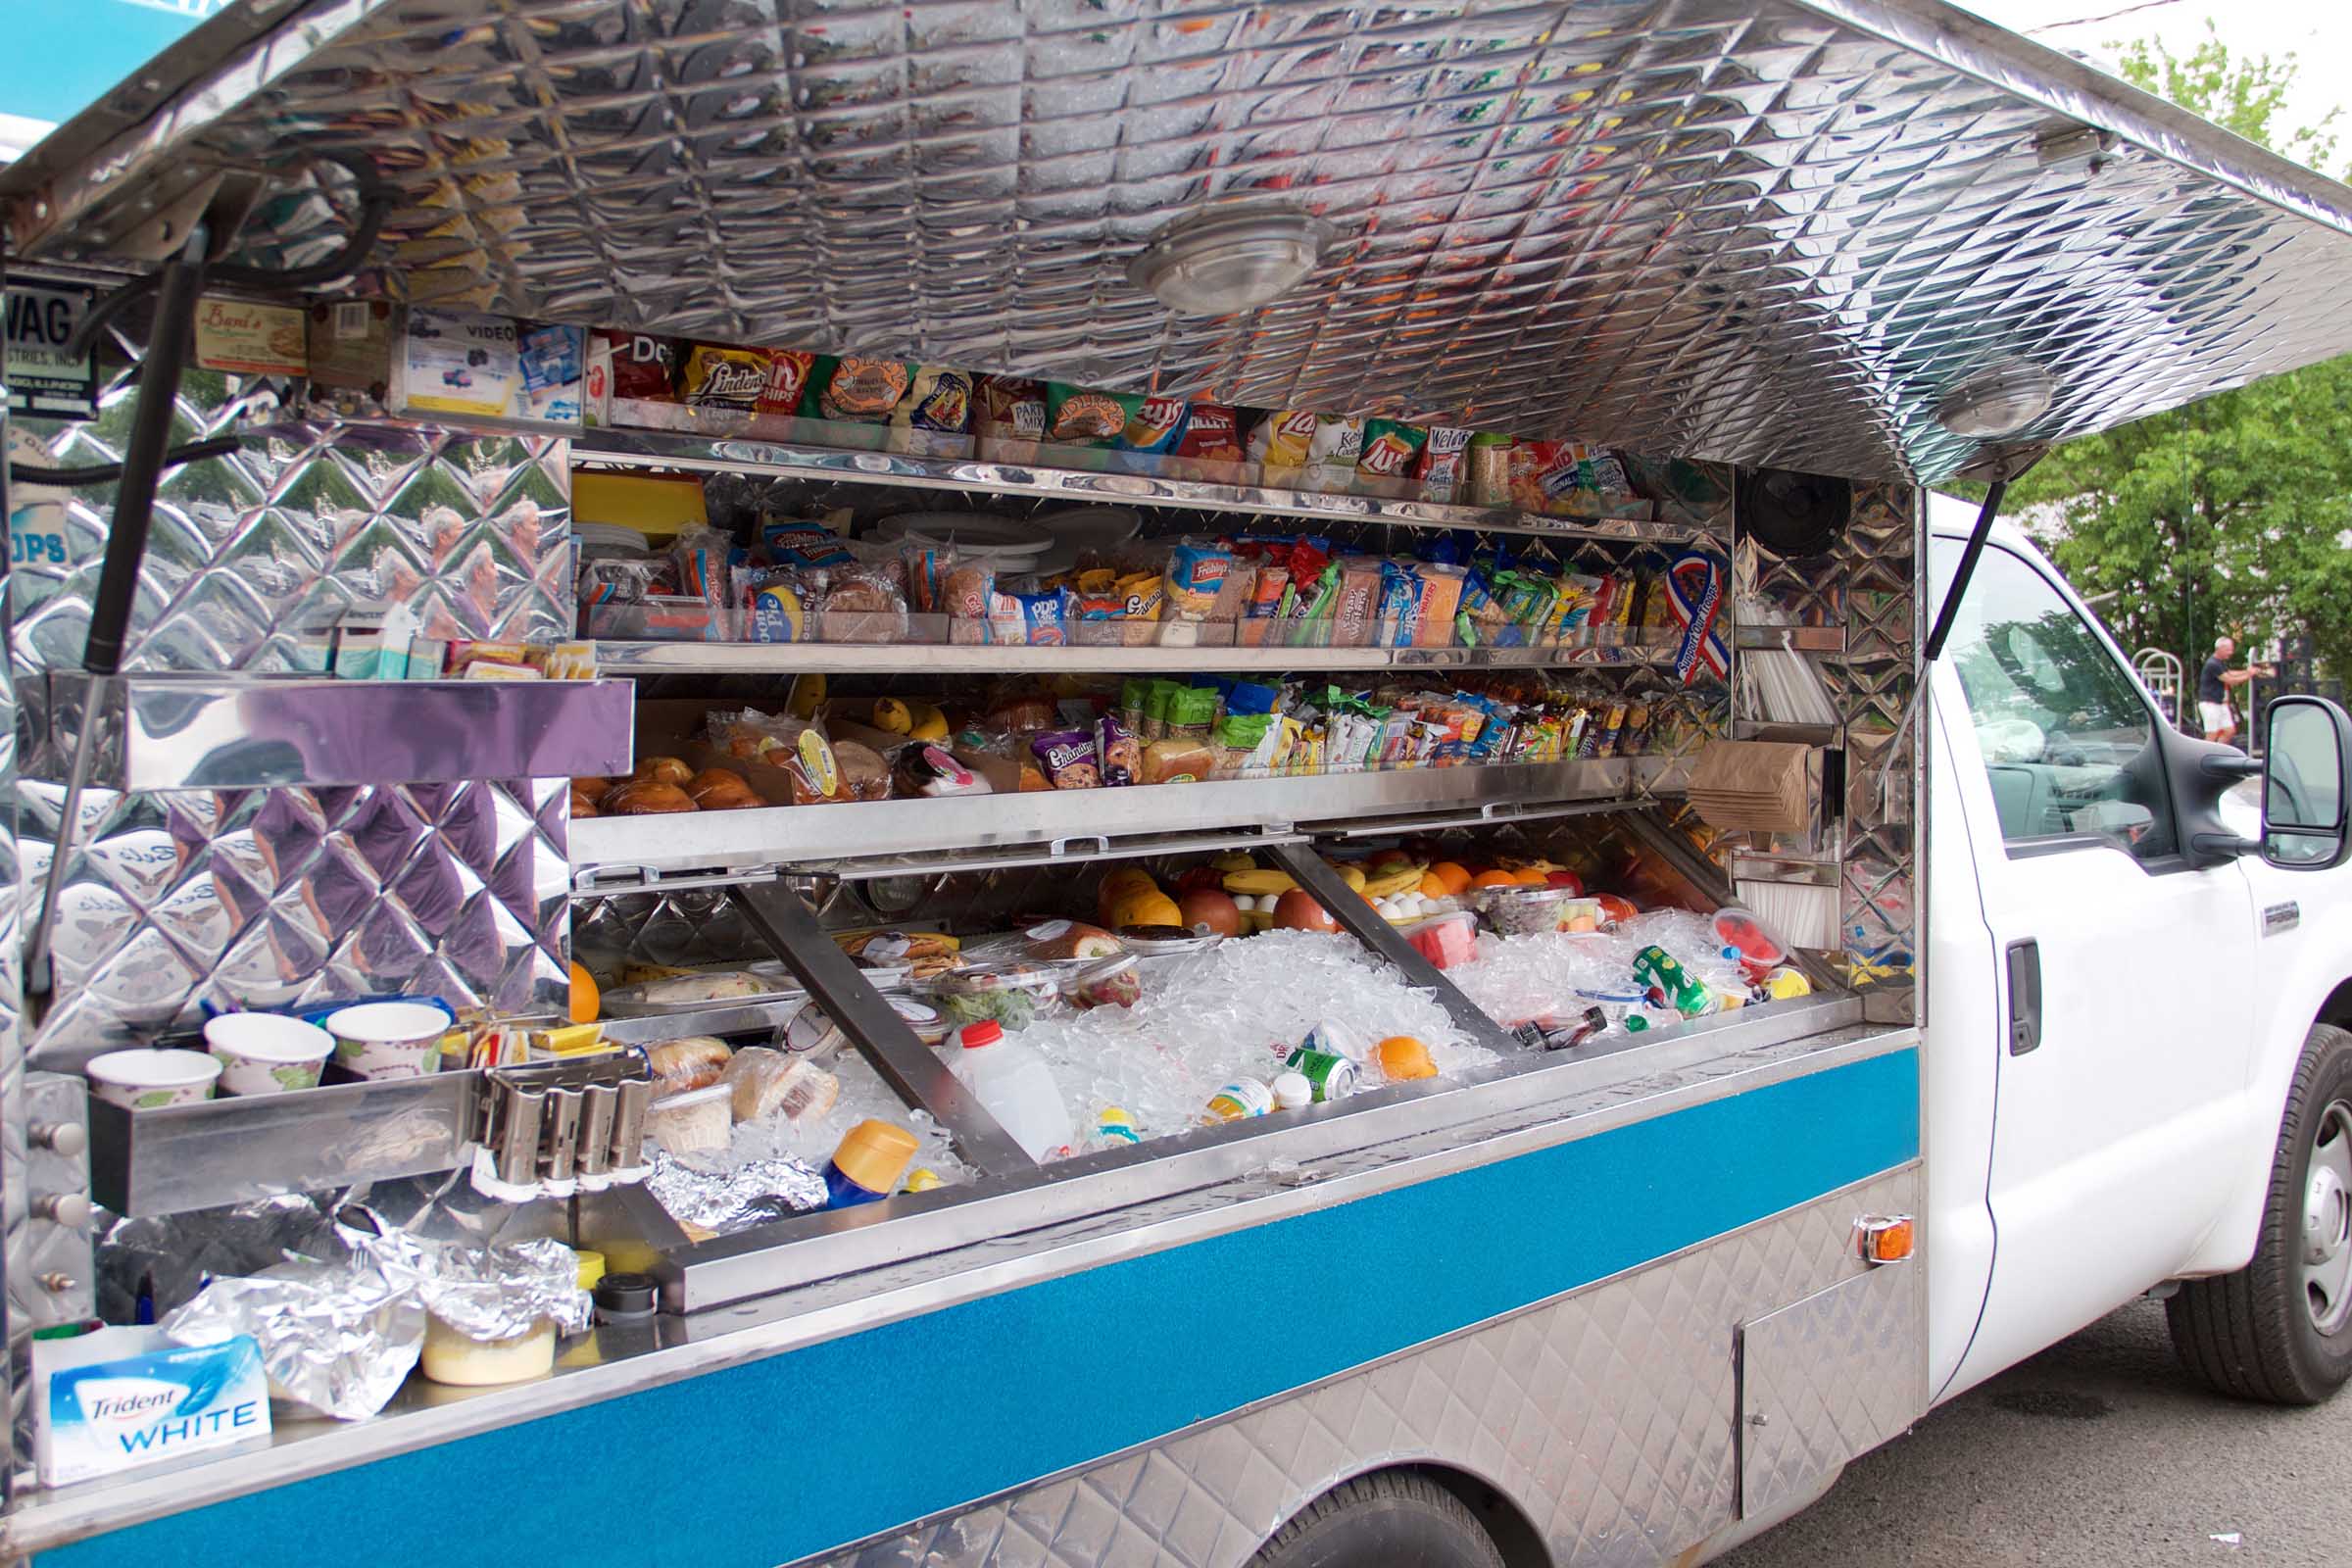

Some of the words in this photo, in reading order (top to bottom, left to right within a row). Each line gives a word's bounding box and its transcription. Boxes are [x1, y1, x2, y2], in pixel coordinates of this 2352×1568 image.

[466, 324, 515, 341] VIDEO
[764, 389, 796, 402] HIPS
[1024, 416, 1045, 431] MIX
[1140, 397, 1183, 430] ay's
[766, 598, 783, 627] Pie
[1124, 587, 1163, 616] Grandma
[1697, 583, 1719, 616] Troops
[1690, 614, 1707, 636] Our
[1677, 635, 1700, 673] Support
[1047, 739, 1096, 768] Grandm
[93, 1390, 174, 1420] Trident
[120, 1400, 258, 1454] WHITE
